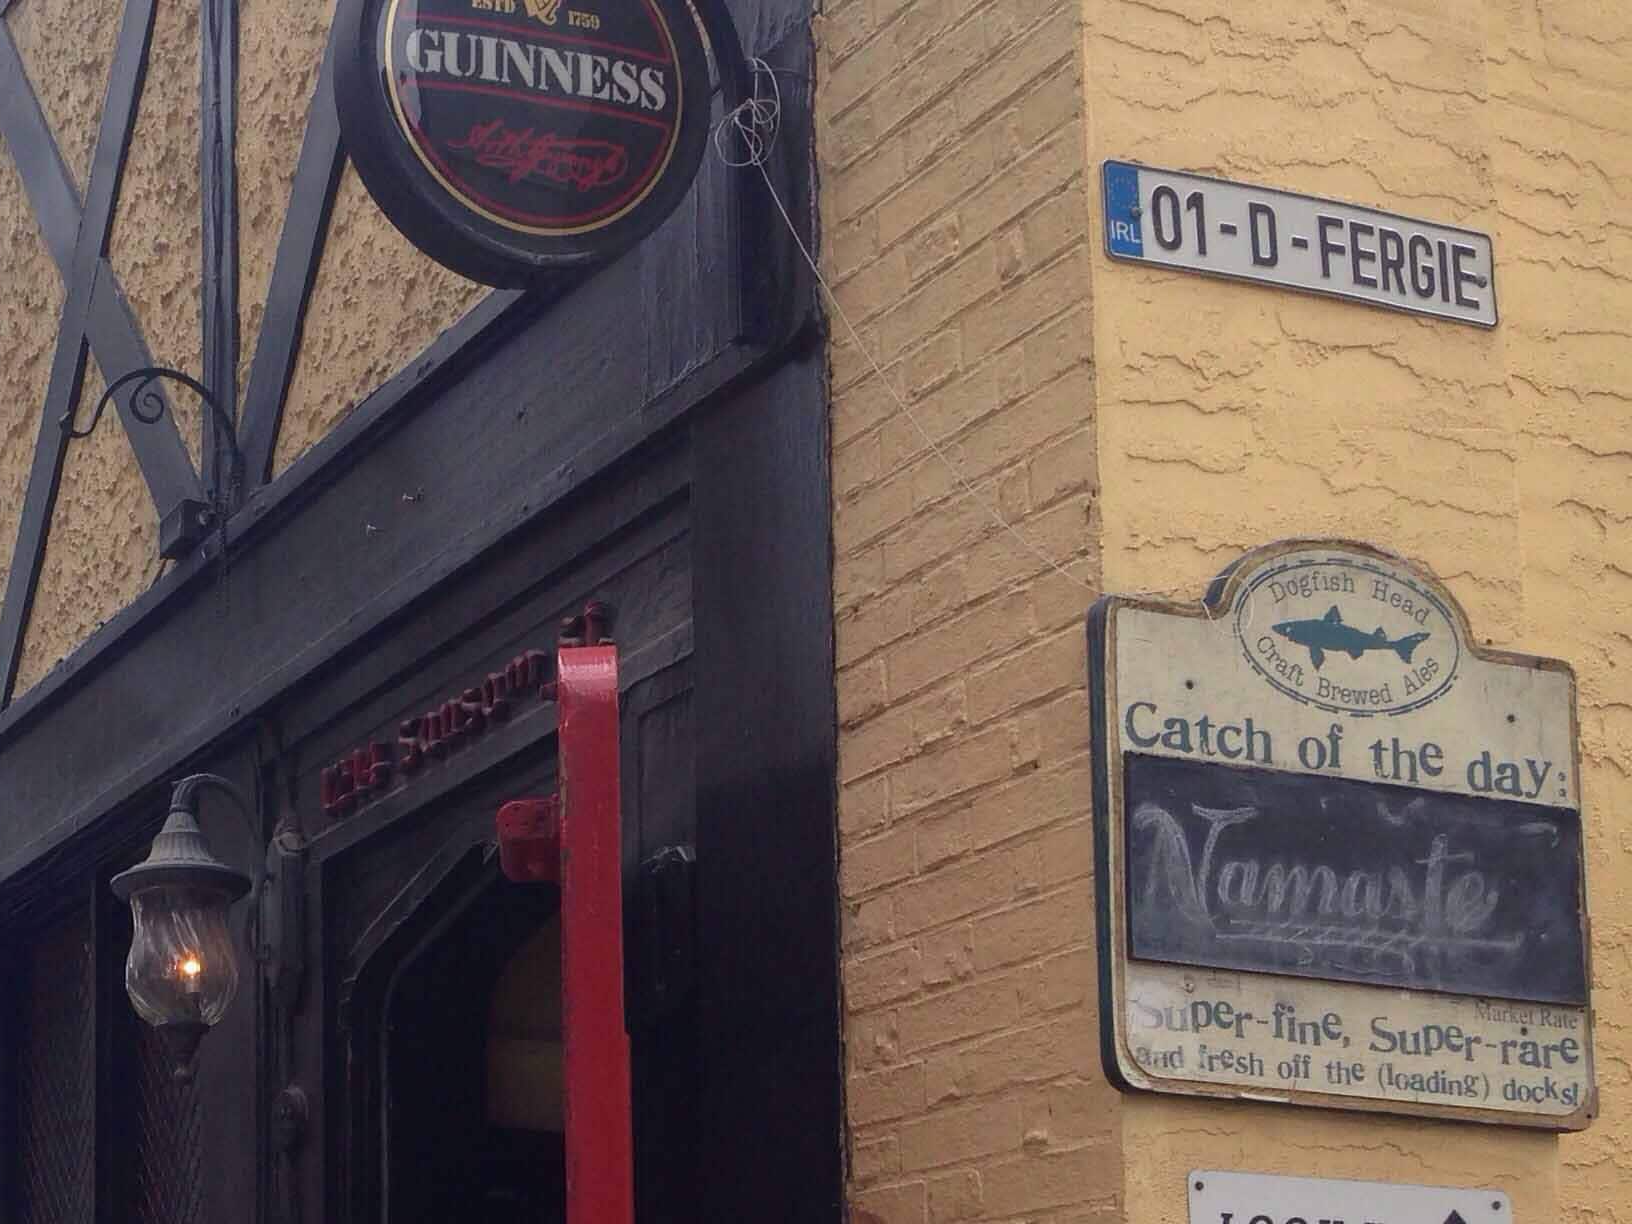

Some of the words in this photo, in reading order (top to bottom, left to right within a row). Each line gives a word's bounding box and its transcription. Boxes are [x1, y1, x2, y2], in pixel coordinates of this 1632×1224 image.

[568, 10, 601, 29] 1759
[405, 27, 667, 111] GUINNESS
[1111, 220, 1141, 244] IRL
[1268, 571, 1356, 604] Dogfish
[1371, 579, 1430, 626] Head
[1257, 635, 1305, 687] Craft
[1317, 677, 1393, 705] Brewed
[1402, 656, 1440, 697] Ales
[1125, 700, 1273, 764] Catch
[1297, 723, 1344, 770] of
[1369, 737, 1444, 783] the
[1467, 751, 1567, 798] day:
[1134, 803, 1499, 929] Namaste
[1134, 998, 1351, 1048] Super-fine,
[1369, 1016, 1579, 1069] Super-rare
[1474, 1003, 1535, 1025] Market
[1540, 1008, 1578, 1030] Rate
[1136, 1045, 1184, 1068] and
[1199, 1045, 1264, 1077] fresh
[1277, 1054, 1311, 1080] off
[1325, 1060, 1365, 1085] the
[1378, 1062, 1490, 1101] (loading)
[1503, 1076, 1578, 1107] docks!
